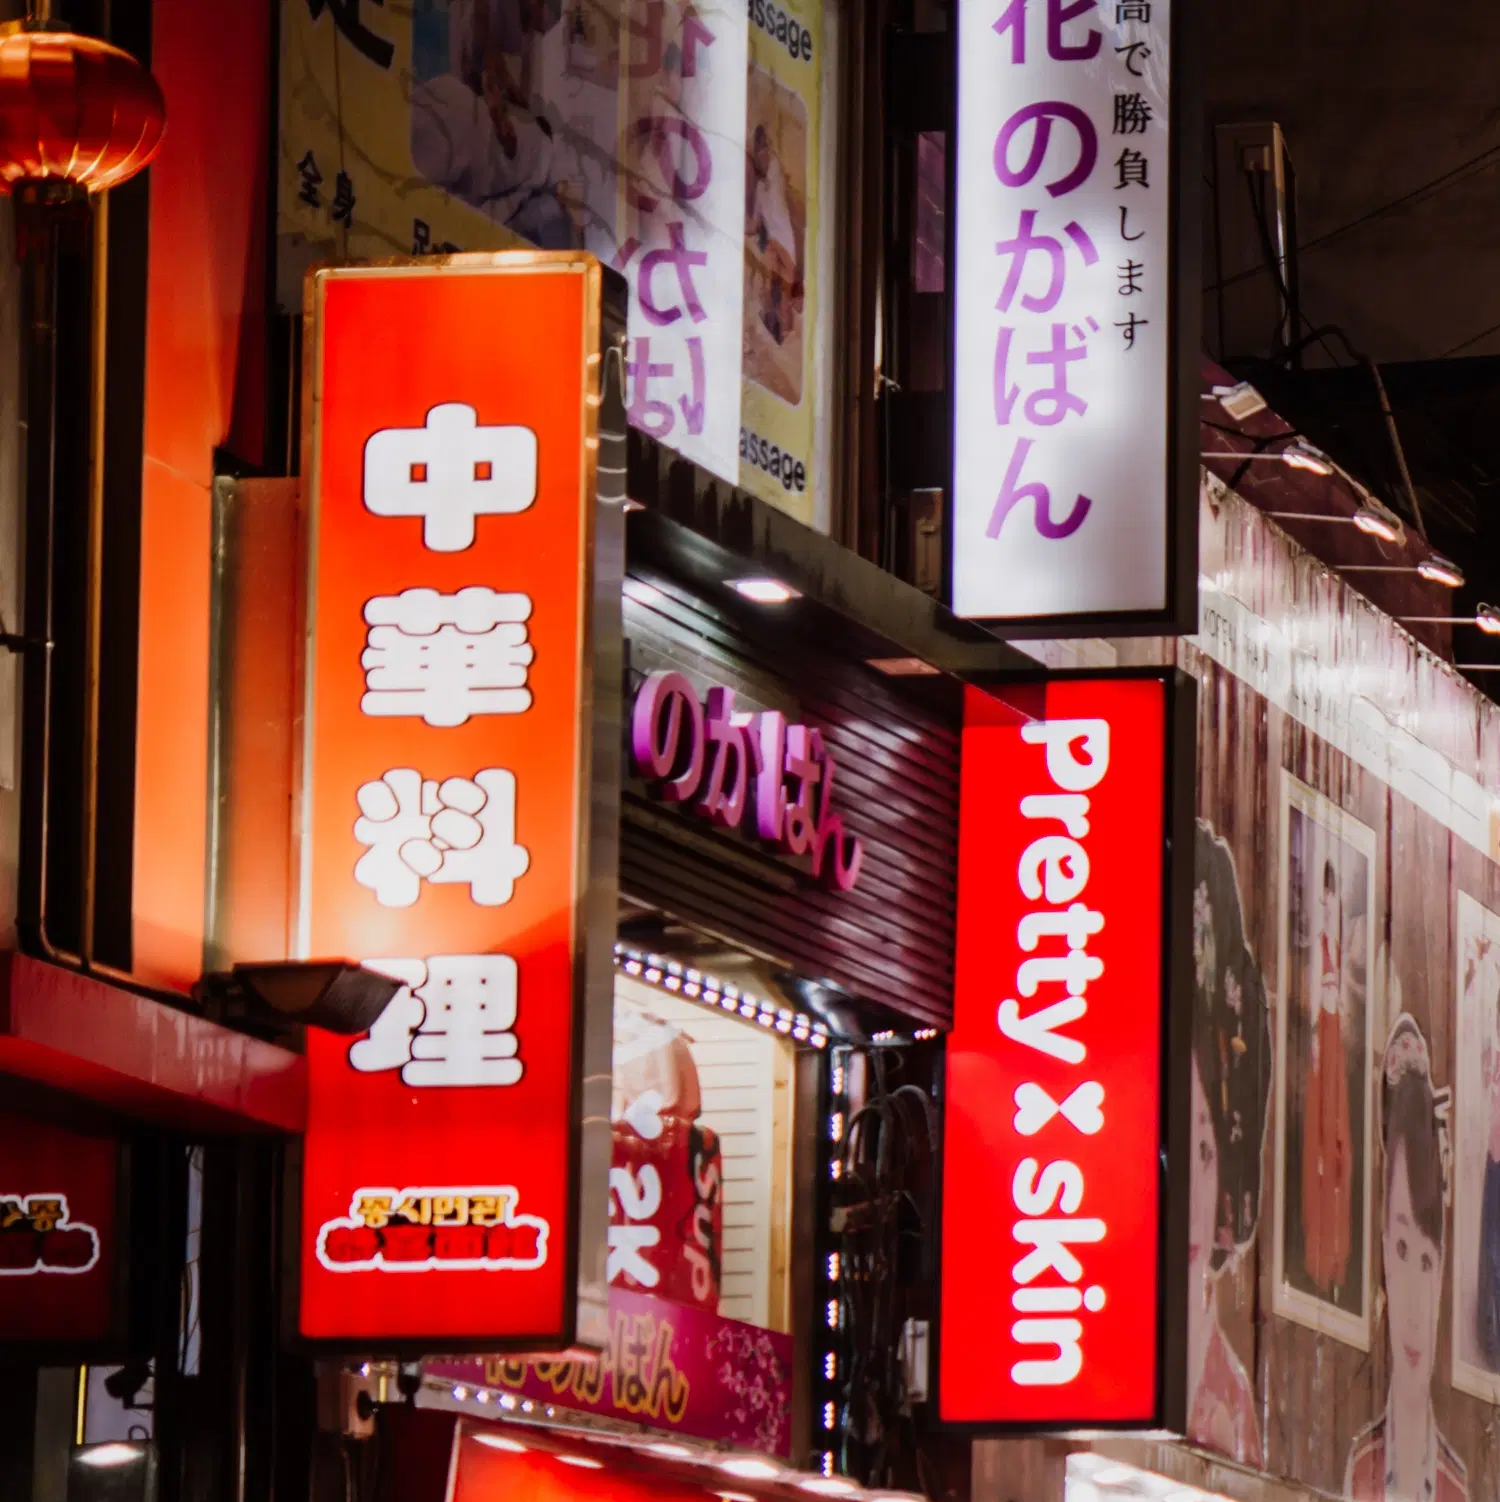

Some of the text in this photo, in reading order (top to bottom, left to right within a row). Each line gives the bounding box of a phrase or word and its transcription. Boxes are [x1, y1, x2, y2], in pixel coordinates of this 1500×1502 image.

[748, 0, 813, 62] ssage
[741, 425, 806, 493] assage
[349, 402, 539, 1088] 中華料理
[633, 670, 862, 892] のかばん
[1011, 1158, 1107, 1386] skin
